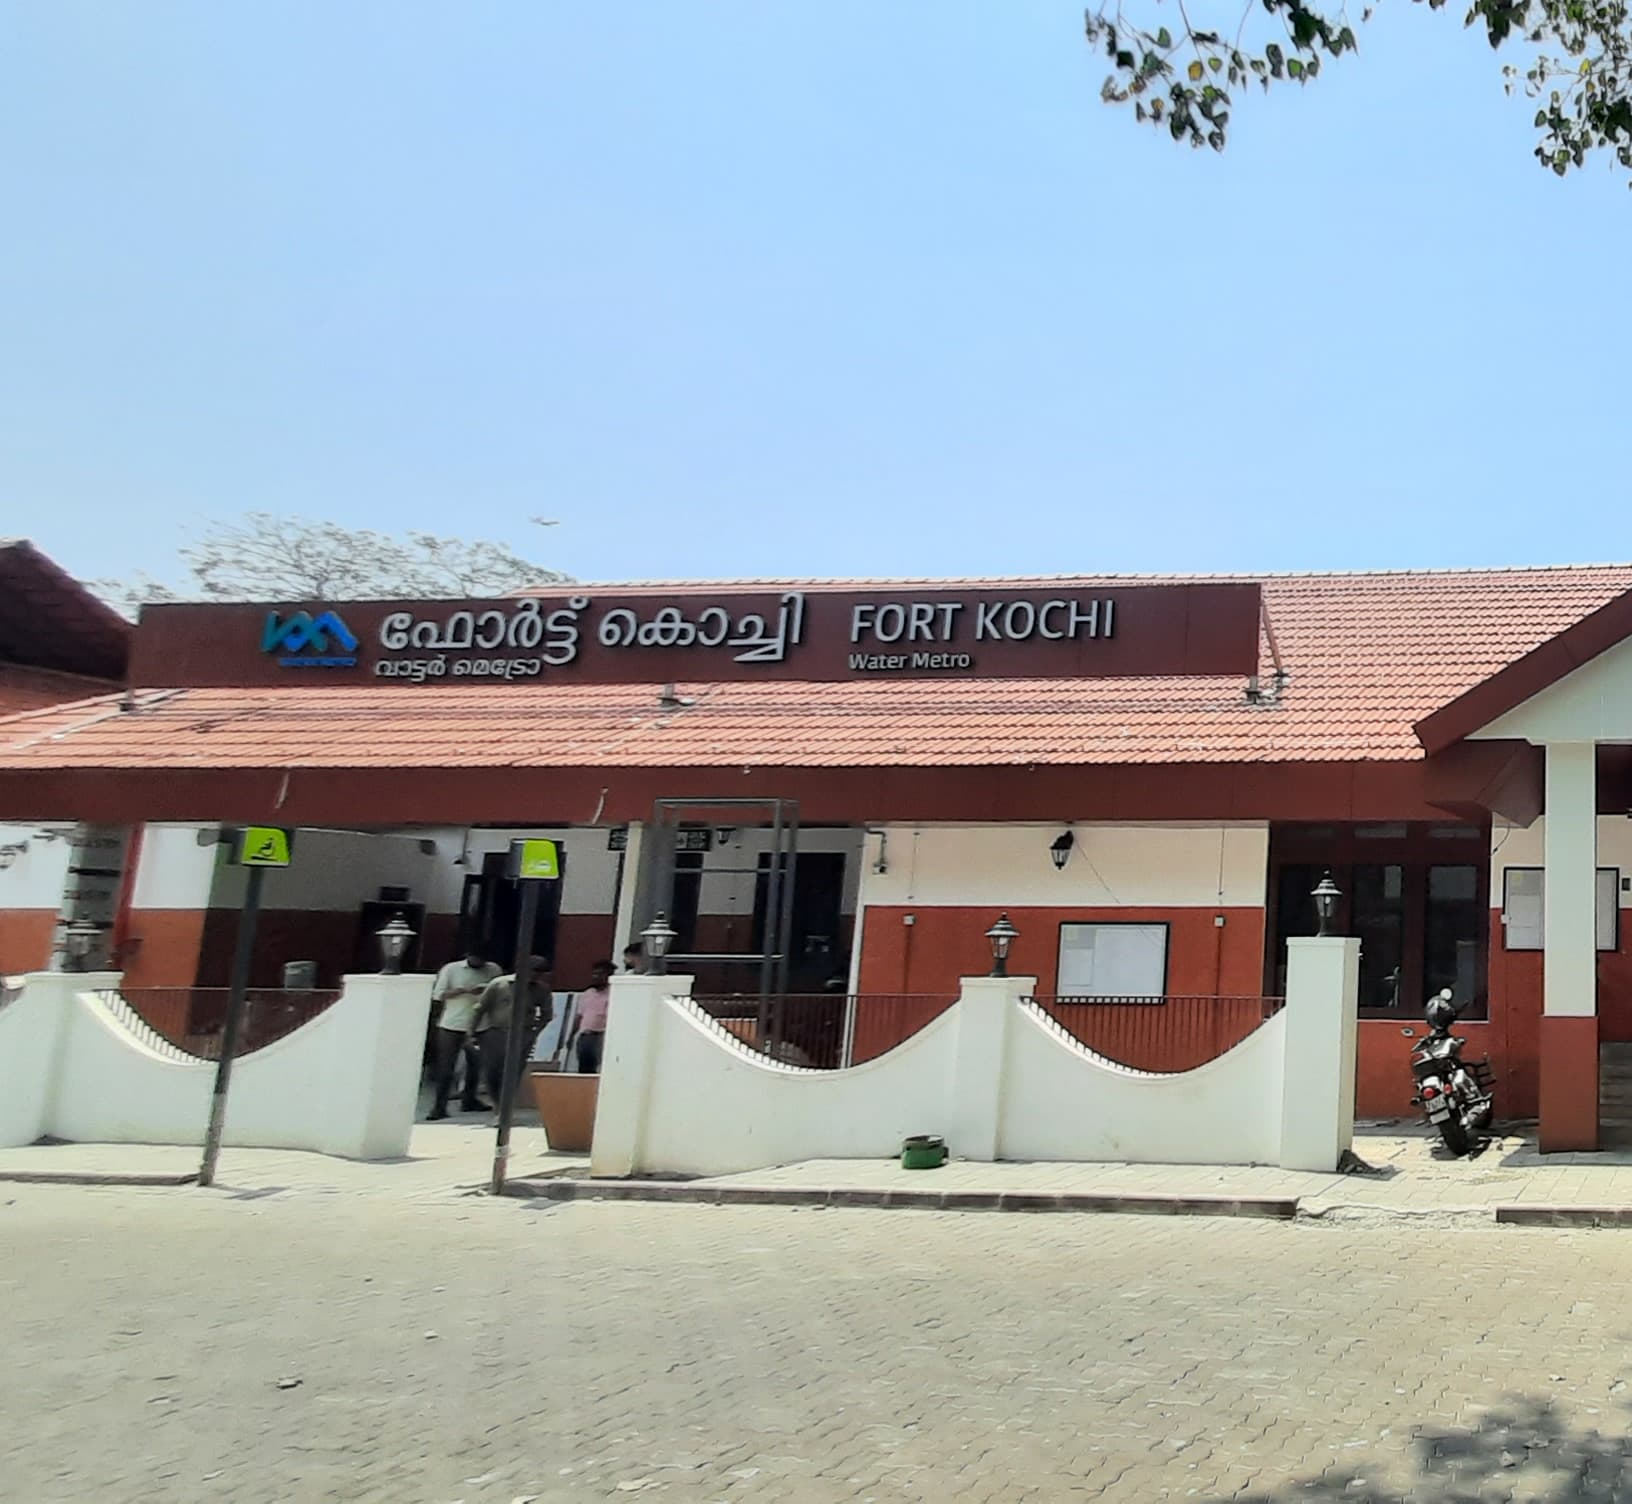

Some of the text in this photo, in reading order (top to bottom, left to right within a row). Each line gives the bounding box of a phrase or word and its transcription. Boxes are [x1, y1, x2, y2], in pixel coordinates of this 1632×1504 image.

[599, 591, 805, 664] കൊച്ചി
[850, 599, 1115, 644] FORT KOCHI
[848, 651, 971, 671] Water Metro
